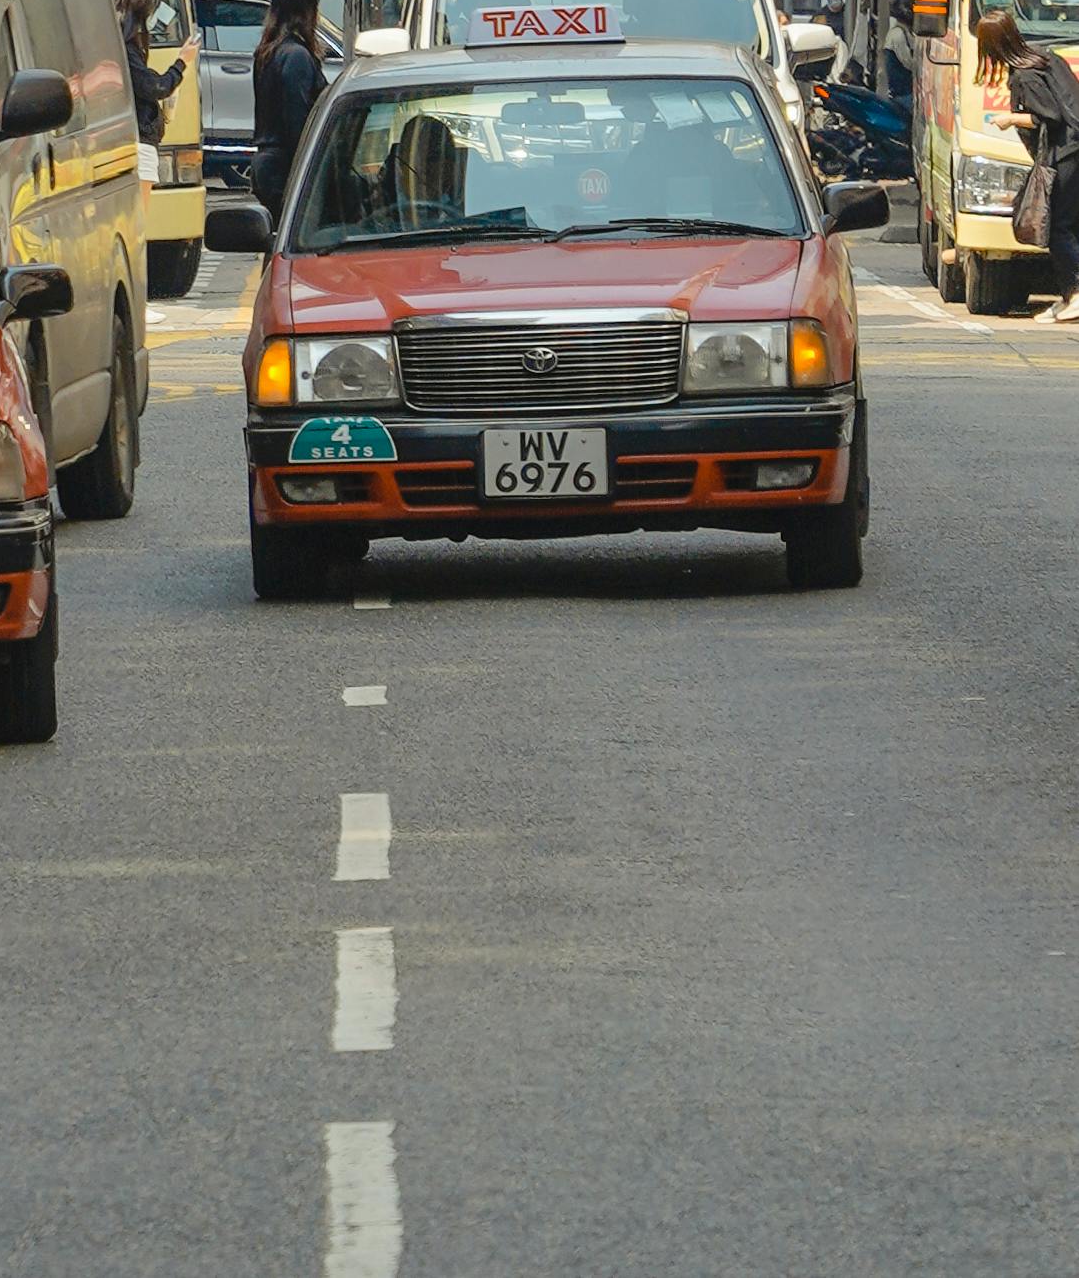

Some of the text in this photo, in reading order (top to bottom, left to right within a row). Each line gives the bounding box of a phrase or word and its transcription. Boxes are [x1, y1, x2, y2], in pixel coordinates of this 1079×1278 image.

[482, 7, 607, 39] TAXI
[581, 177, 607, 195] TAXI
[331, 424, 353, 445] 4
[519, 431, 569, 462] WV
[311, 446, 374, 459] SEATS
[495, 461, 597, 494] 6976
